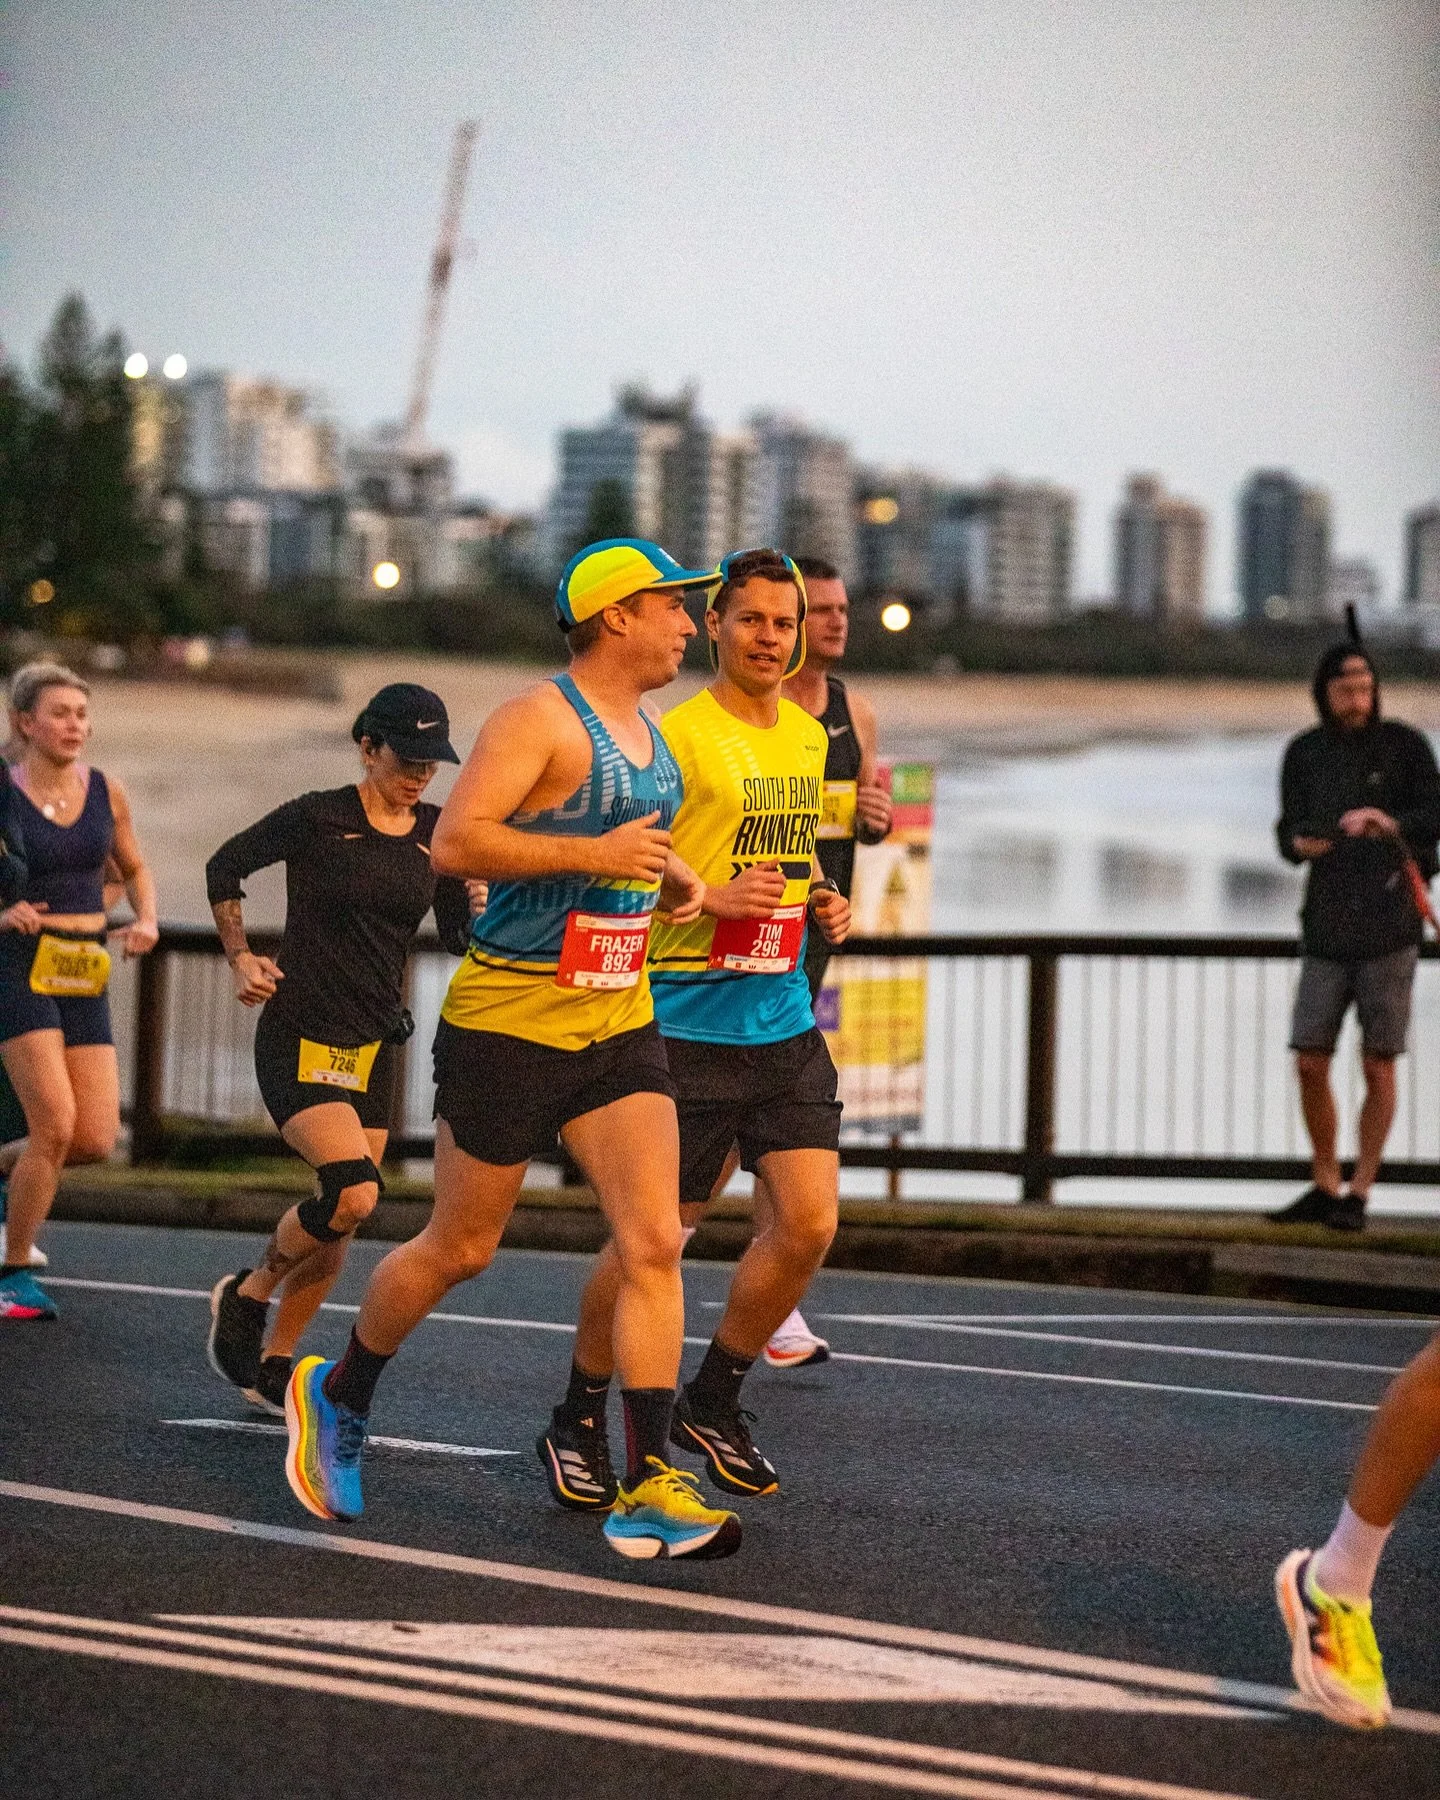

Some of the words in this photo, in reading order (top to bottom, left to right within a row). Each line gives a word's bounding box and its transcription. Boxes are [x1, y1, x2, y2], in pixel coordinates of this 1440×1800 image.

[743, 777, 785, 812] SOUTH
[789, 776, 820, 809] BANK
[731, 813, 819, 856] RUNNERS
[759, 923, 783, 940] TIM
[590, 934, 644, 953] FRAZER
[750, 940, 780, 957] 296
[602, 953, 632, 972] 892
[329, 1055, 356, 1074] 7246
